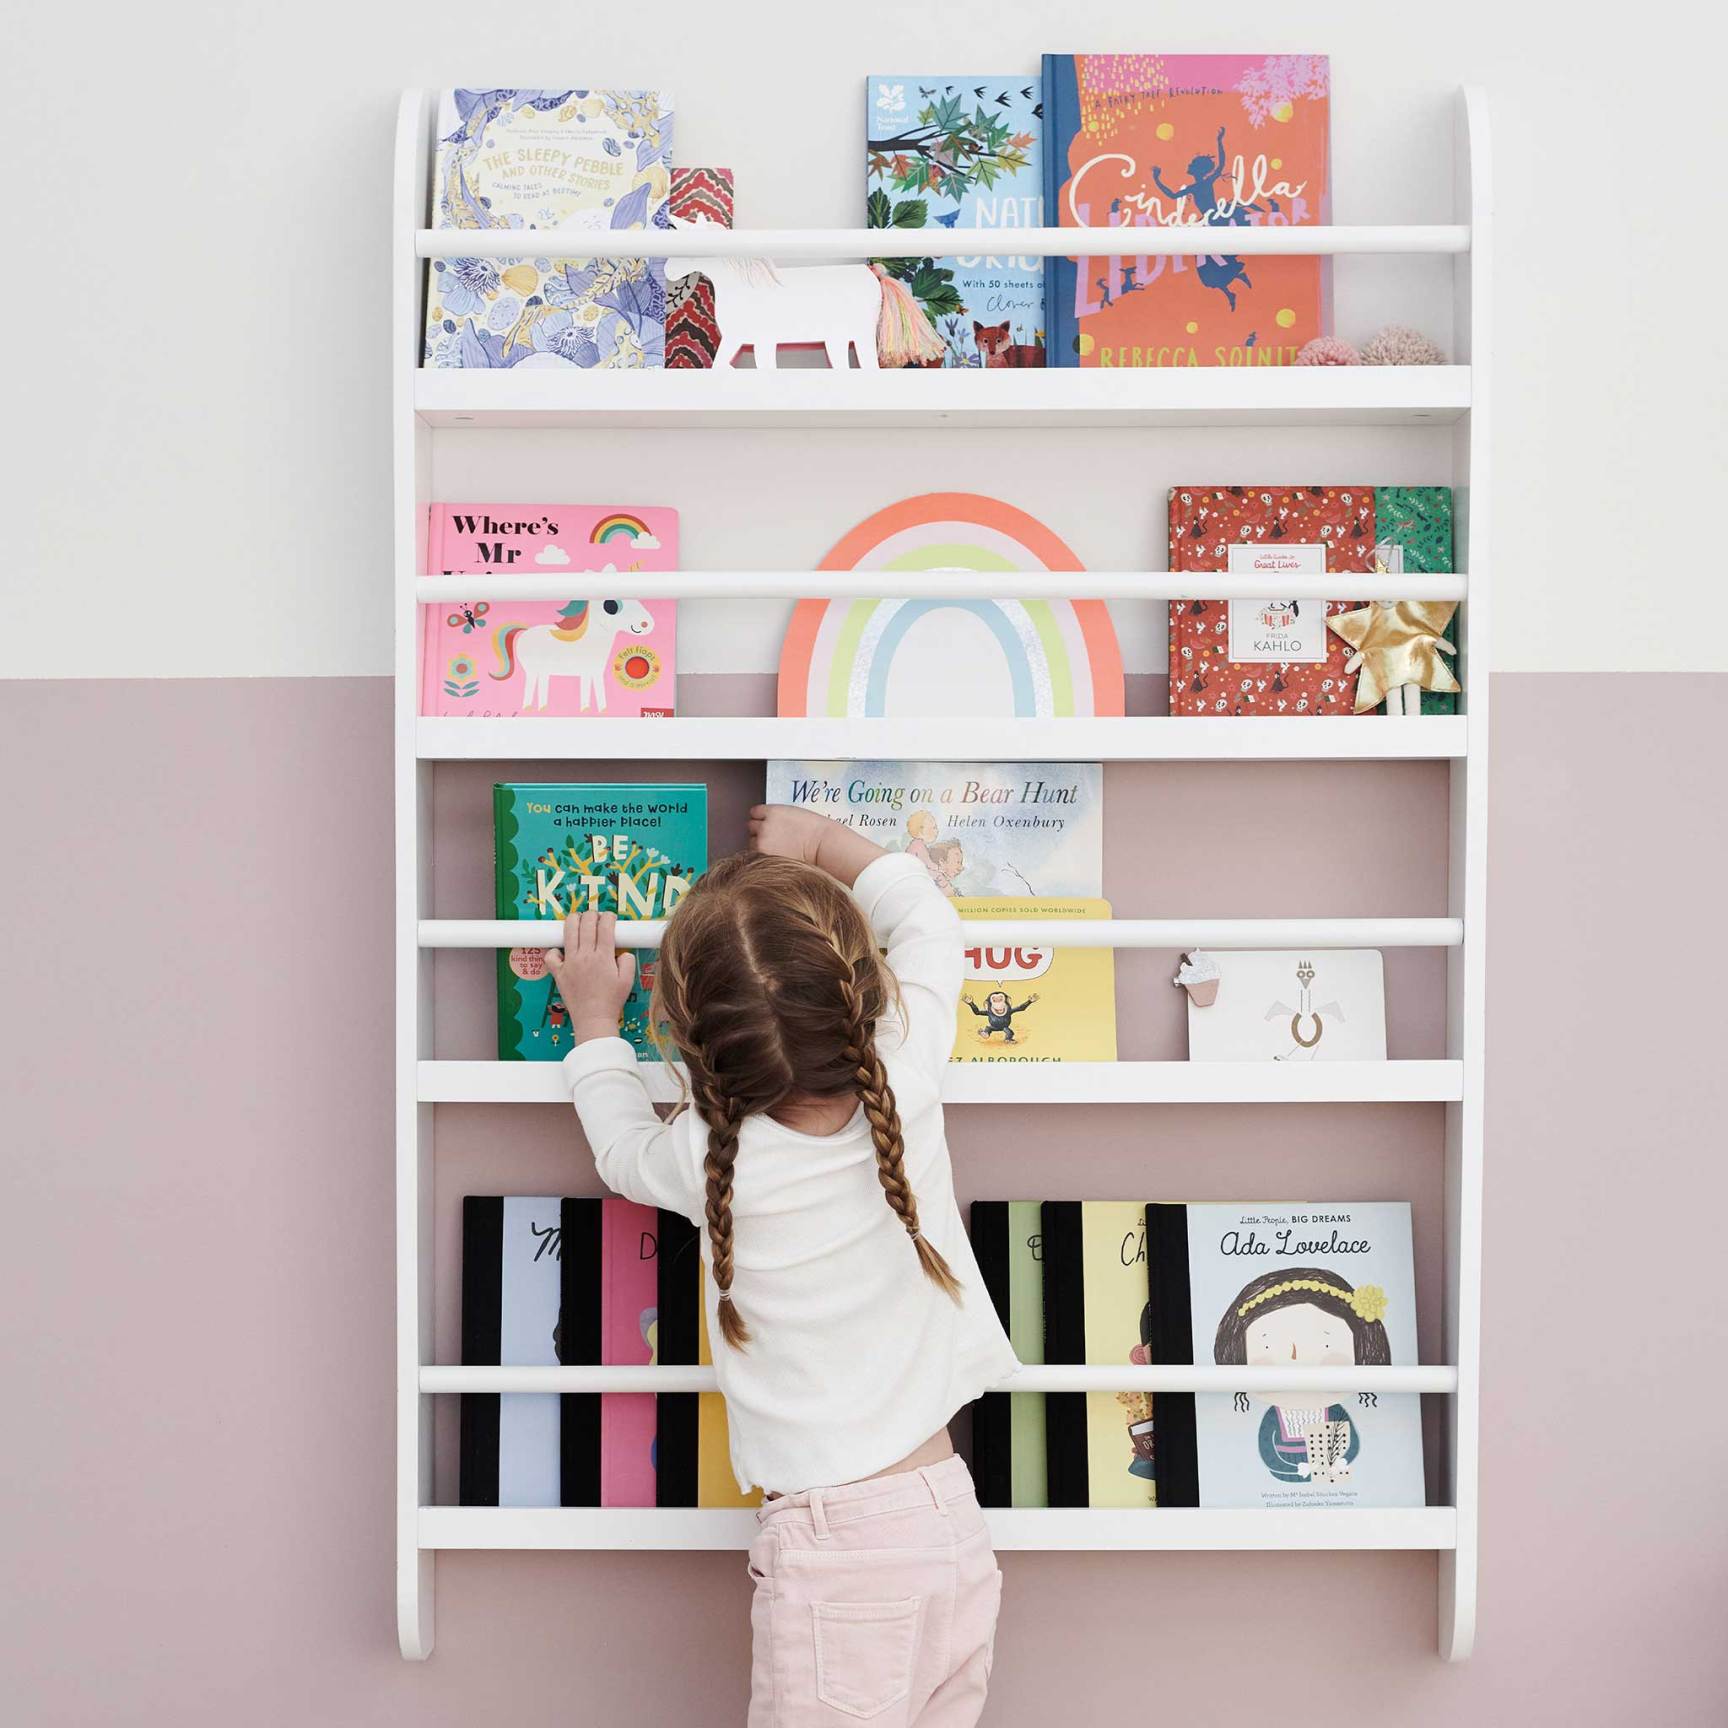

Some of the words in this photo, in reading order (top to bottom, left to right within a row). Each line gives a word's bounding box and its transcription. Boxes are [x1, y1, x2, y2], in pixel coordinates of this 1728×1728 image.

[482, 151, 513, 171] THE
[517, 148, 573, 166] SLEEPY
[574, 156, 625, 176] PEBBLE
[491, 181, 521, 191] CALMING
[502, 166, 526, 179] AND
[529, 165, 568, 180] OTHER
[568, 172, 611, 191] STORIES
[962, 279, 985, 289] With
[988, 279, 1001, 289] 50
[1004, 280, 1034, 289] sheets
[986, 294, 1034, 312] Clover
[1100, 346, 1198, 368] REBECCA
[452, 515, 559, 536] Where's
[474, 542, 522, 564] Mr
[1254, 559, 1277, 569] Great
[1277, 559, 1303, 569] Lives
[1266, 632, 1288, 640] FRIDA
[1253, 640, 1302, 652] KAHLO
[792, 780, 841, 803] We're
[848, 780, 906, 811] Going
[910, 787, 934, 804] on
[940, 787, 954, 804] a
[960, 781, 1014, 804] Bear
[1020, 781, 1079, 804] Hunt
[555, 803, 580, 814] can
[583, 802, 618, 814] make
[622, 803, 643, 814] the
[648, 803, 688, 814] world
[553, 817, 562, 826] a
[565, 816, 617, 828] happier
[621, 816, 661, 828] place!
[859, 814, 897, 827] Rosen
[947, 814, 986, 828] Helen
[993, 814, 1065, 832] Oxenbury
[592, 835, 629, 863] BE
[536, 869, 692, 917] KIND
[991, 906, 1017, 914] COPIES
[1239, 1216, 1261, 1225] Little
[1291, 1215, 1308, 1224] BIG
[1312, 1214, 1351, 1223] DREAMS
[1220, 1231, 1271, 1256] Ada
[1275, 1229, 1372, 1256] Lovelace
